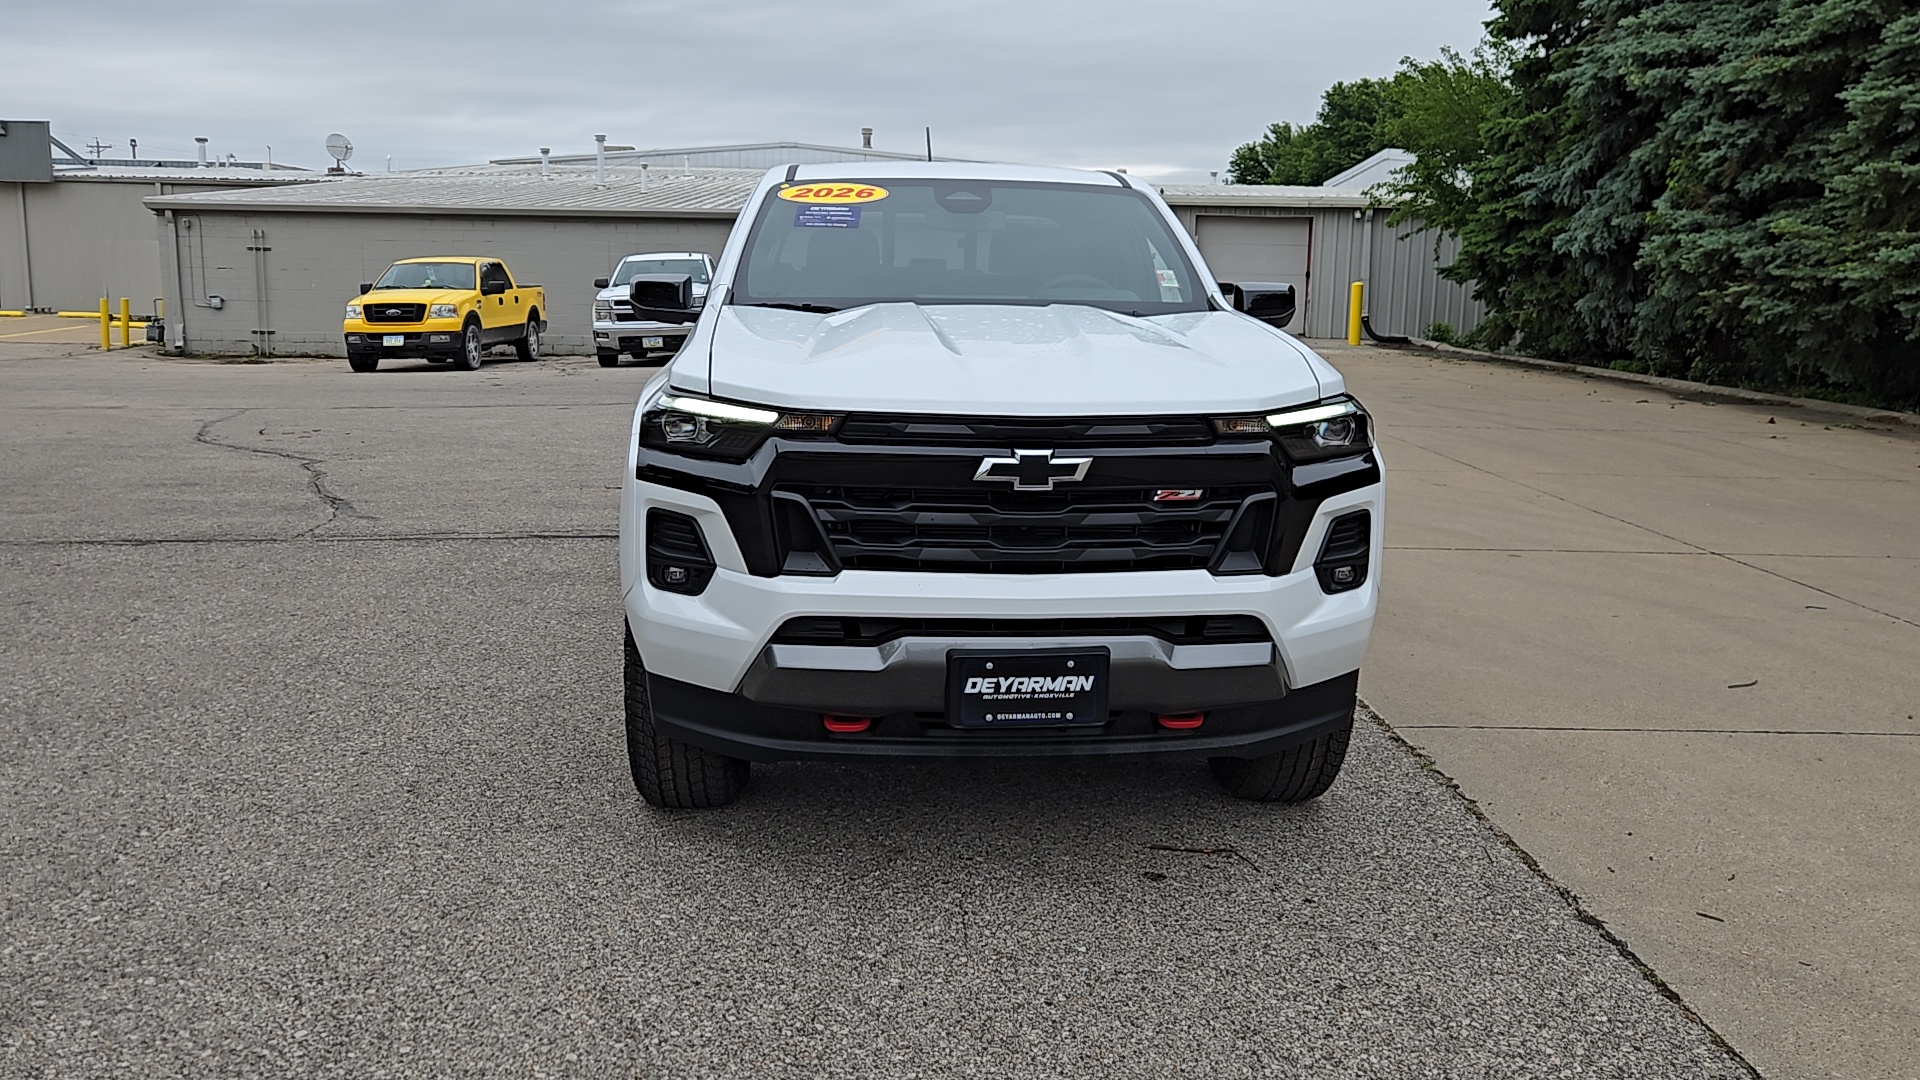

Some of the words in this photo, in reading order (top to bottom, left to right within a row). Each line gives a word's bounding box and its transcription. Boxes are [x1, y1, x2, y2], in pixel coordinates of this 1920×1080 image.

[790, 187, 876, 199] 2026
[964, 675, 1095, 693] DEYARMAN
[996, 712, 1062, 720] DEYARMANAUTO.COM
